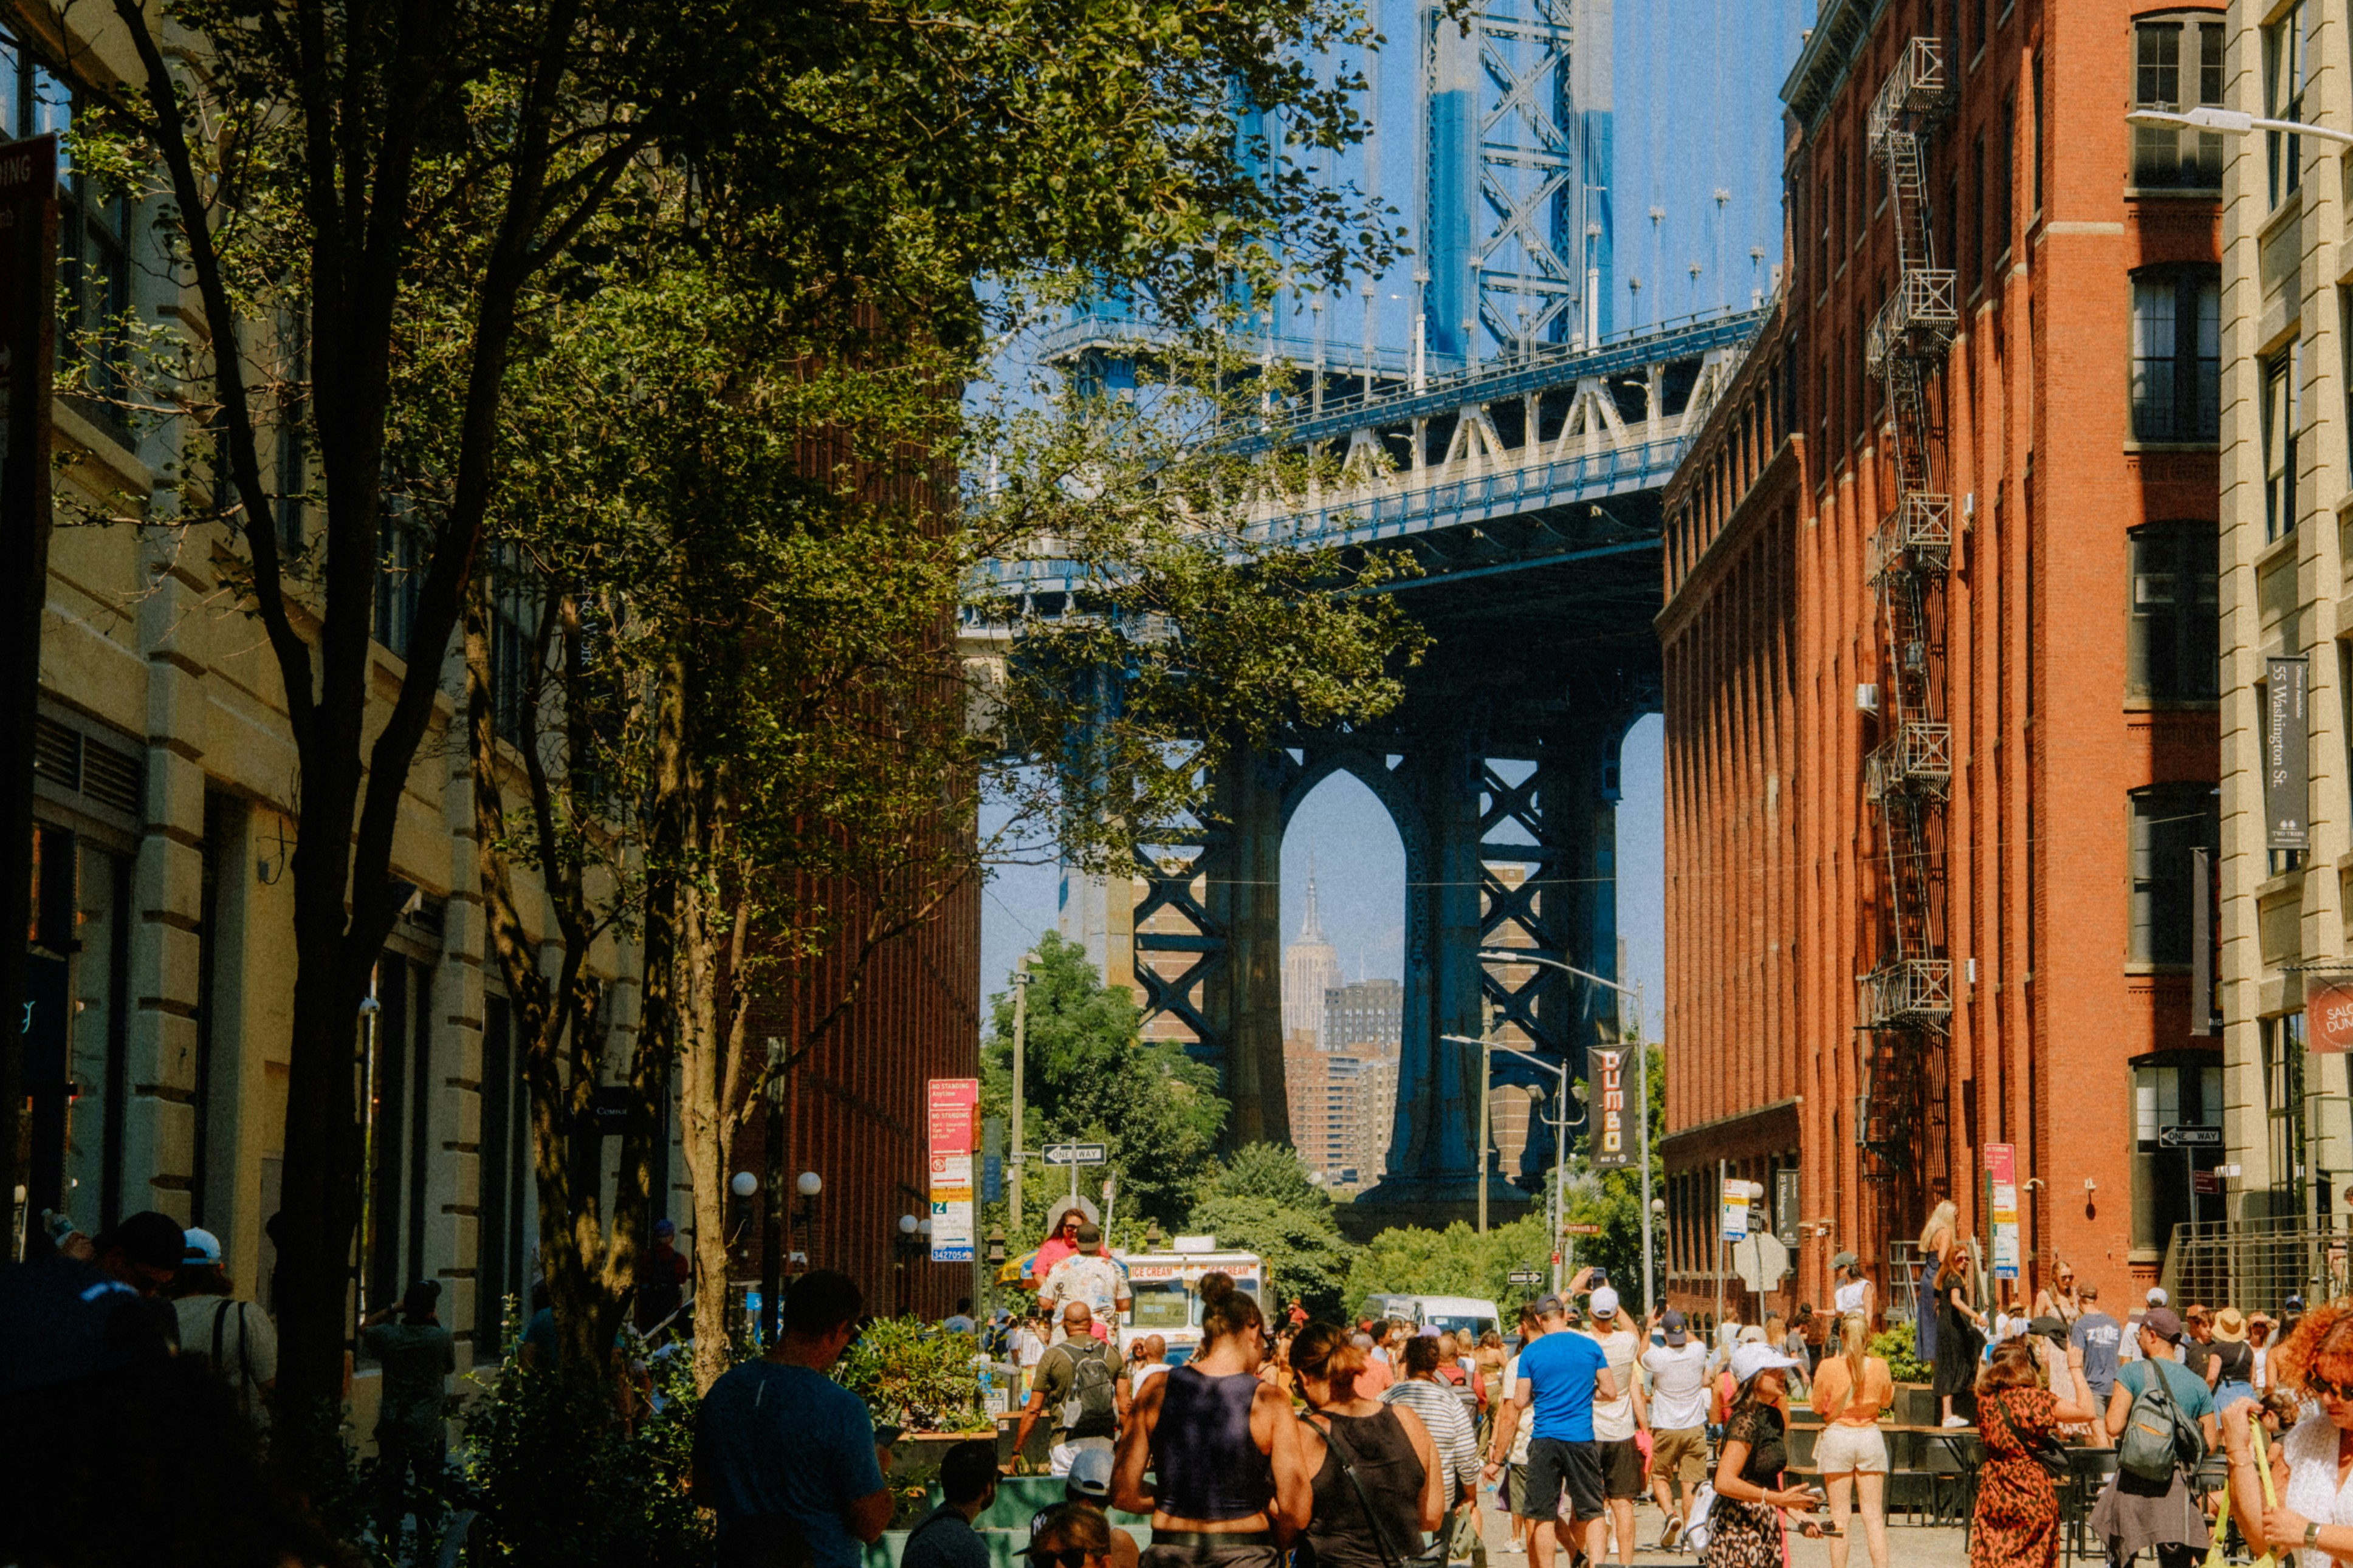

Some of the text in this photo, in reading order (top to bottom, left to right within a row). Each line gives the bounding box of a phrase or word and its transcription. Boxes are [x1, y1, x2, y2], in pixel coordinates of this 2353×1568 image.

[2269, 665, 2287, 788] 55 Washington St.
[2168, 1131, 2217, 1141] ONE WAY
[1052, 1151, 1070, 1159] ONE
[1778, 1183, 1787, 1220] Washington
[934, 1250, 962, 1259] 342705
[1132, 1267, 1173, 1277] ICE CREAM
[1223, 1265, 1249, 1275] CREAM
